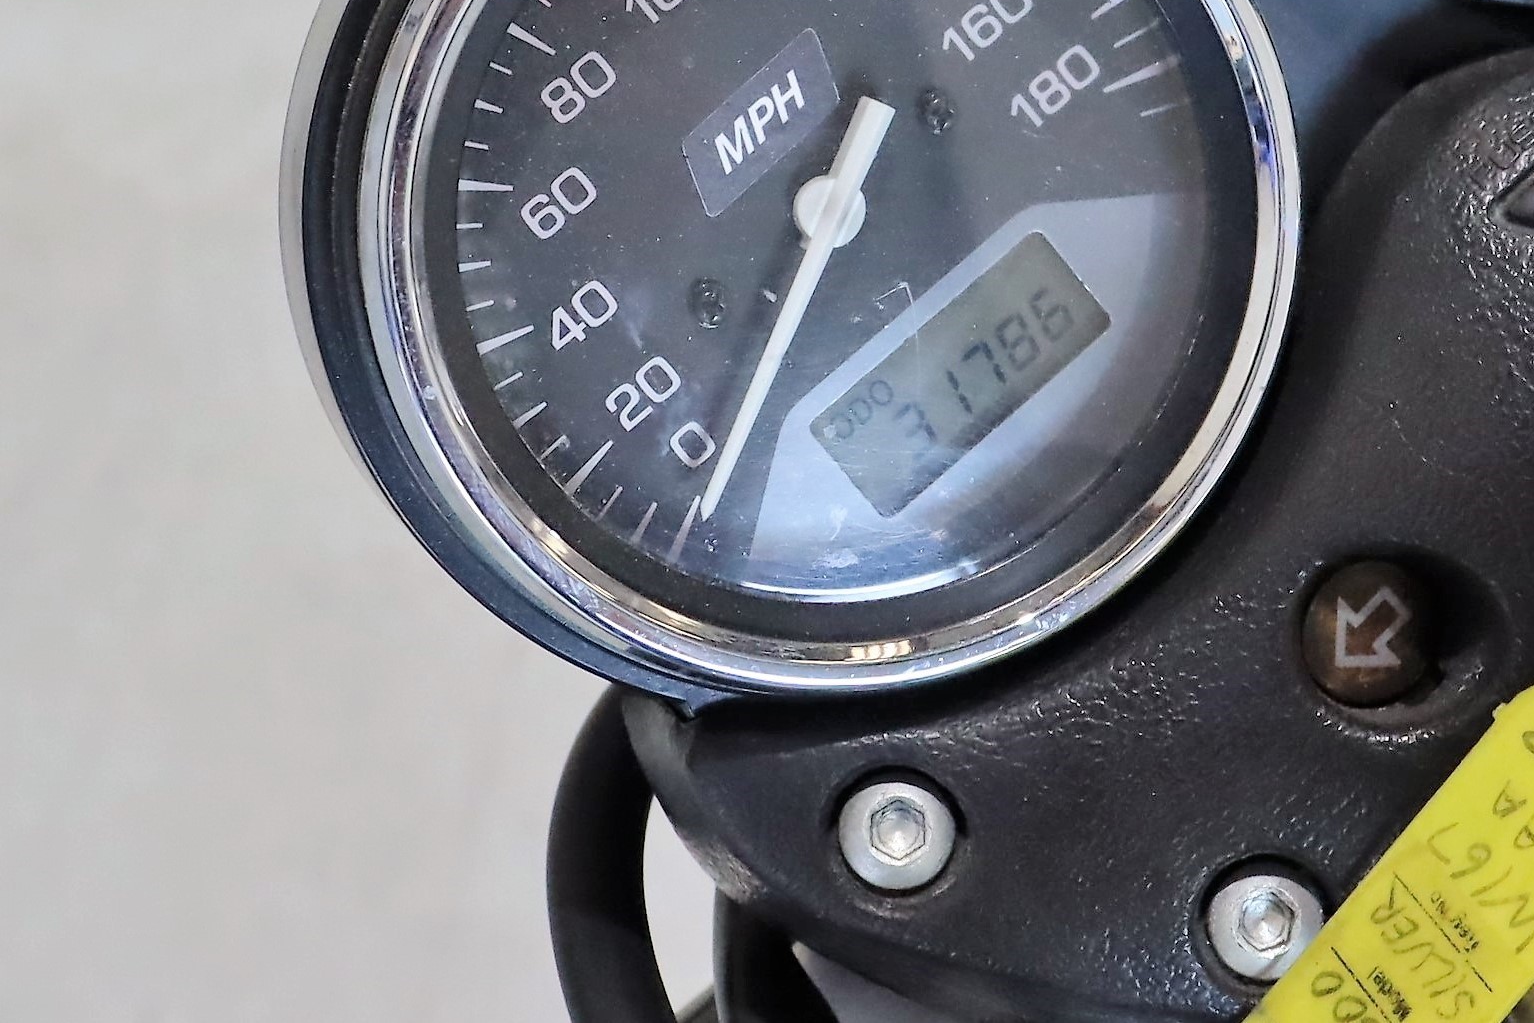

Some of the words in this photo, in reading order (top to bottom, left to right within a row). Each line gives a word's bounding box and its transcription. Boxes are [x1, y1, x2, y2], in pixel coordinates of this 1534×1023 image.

[539, 50, 617, 125] 80
[713, 68, 806, 176] MPH
[1008, 43, 1101, 129] 180
[518, 166, 598, 241] 60
[550, 280, 619, 352] 40
[605, 356, 682, 433] 20
[668, 420, 717, 469] 0
[1370, 878, 1476, 1020] SILVER
